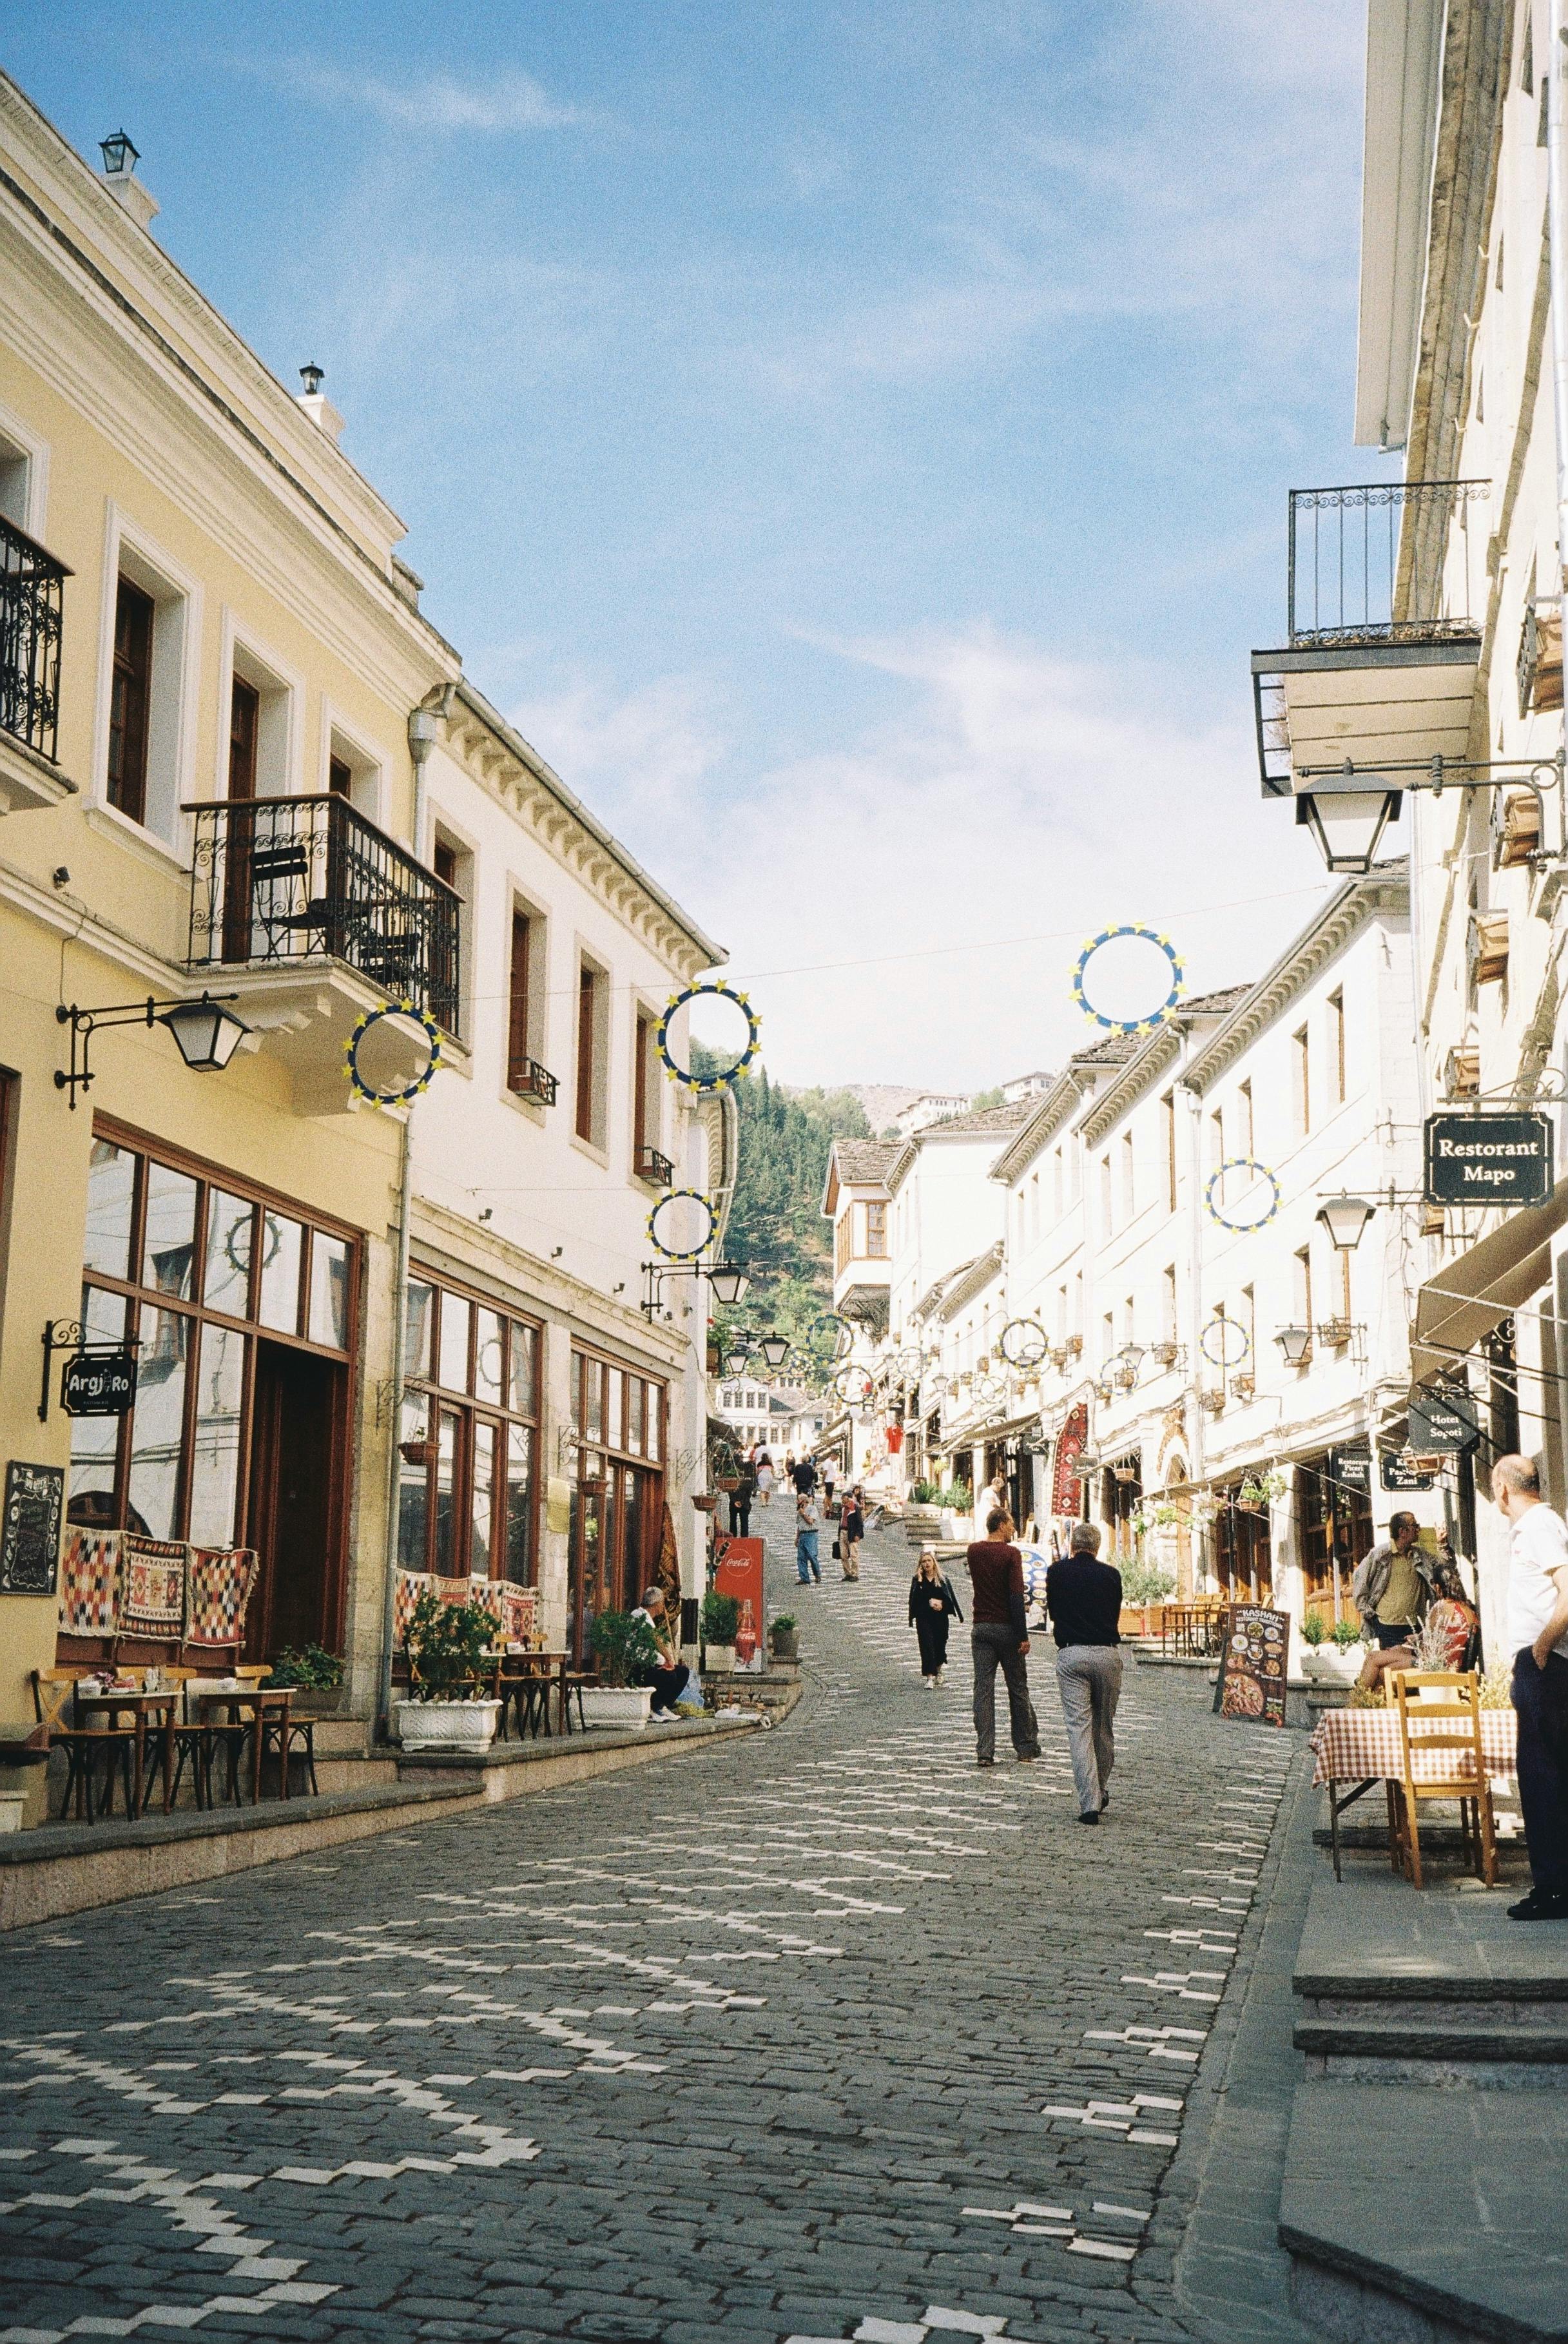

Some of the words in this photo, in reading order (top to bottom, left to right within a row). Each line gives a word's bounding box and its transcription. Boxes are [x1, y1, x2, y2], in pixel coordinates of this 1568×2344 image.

[1438, 1139, 1538, 1157] Restorant
[1463, 1165, 1515, 1186] Mapo
[1431, 1415, 1459, 1424] Hotel
[1430, 1428, 1462, 1439] Sopoti
[1396, 1476, 1418, 1485] Zani
